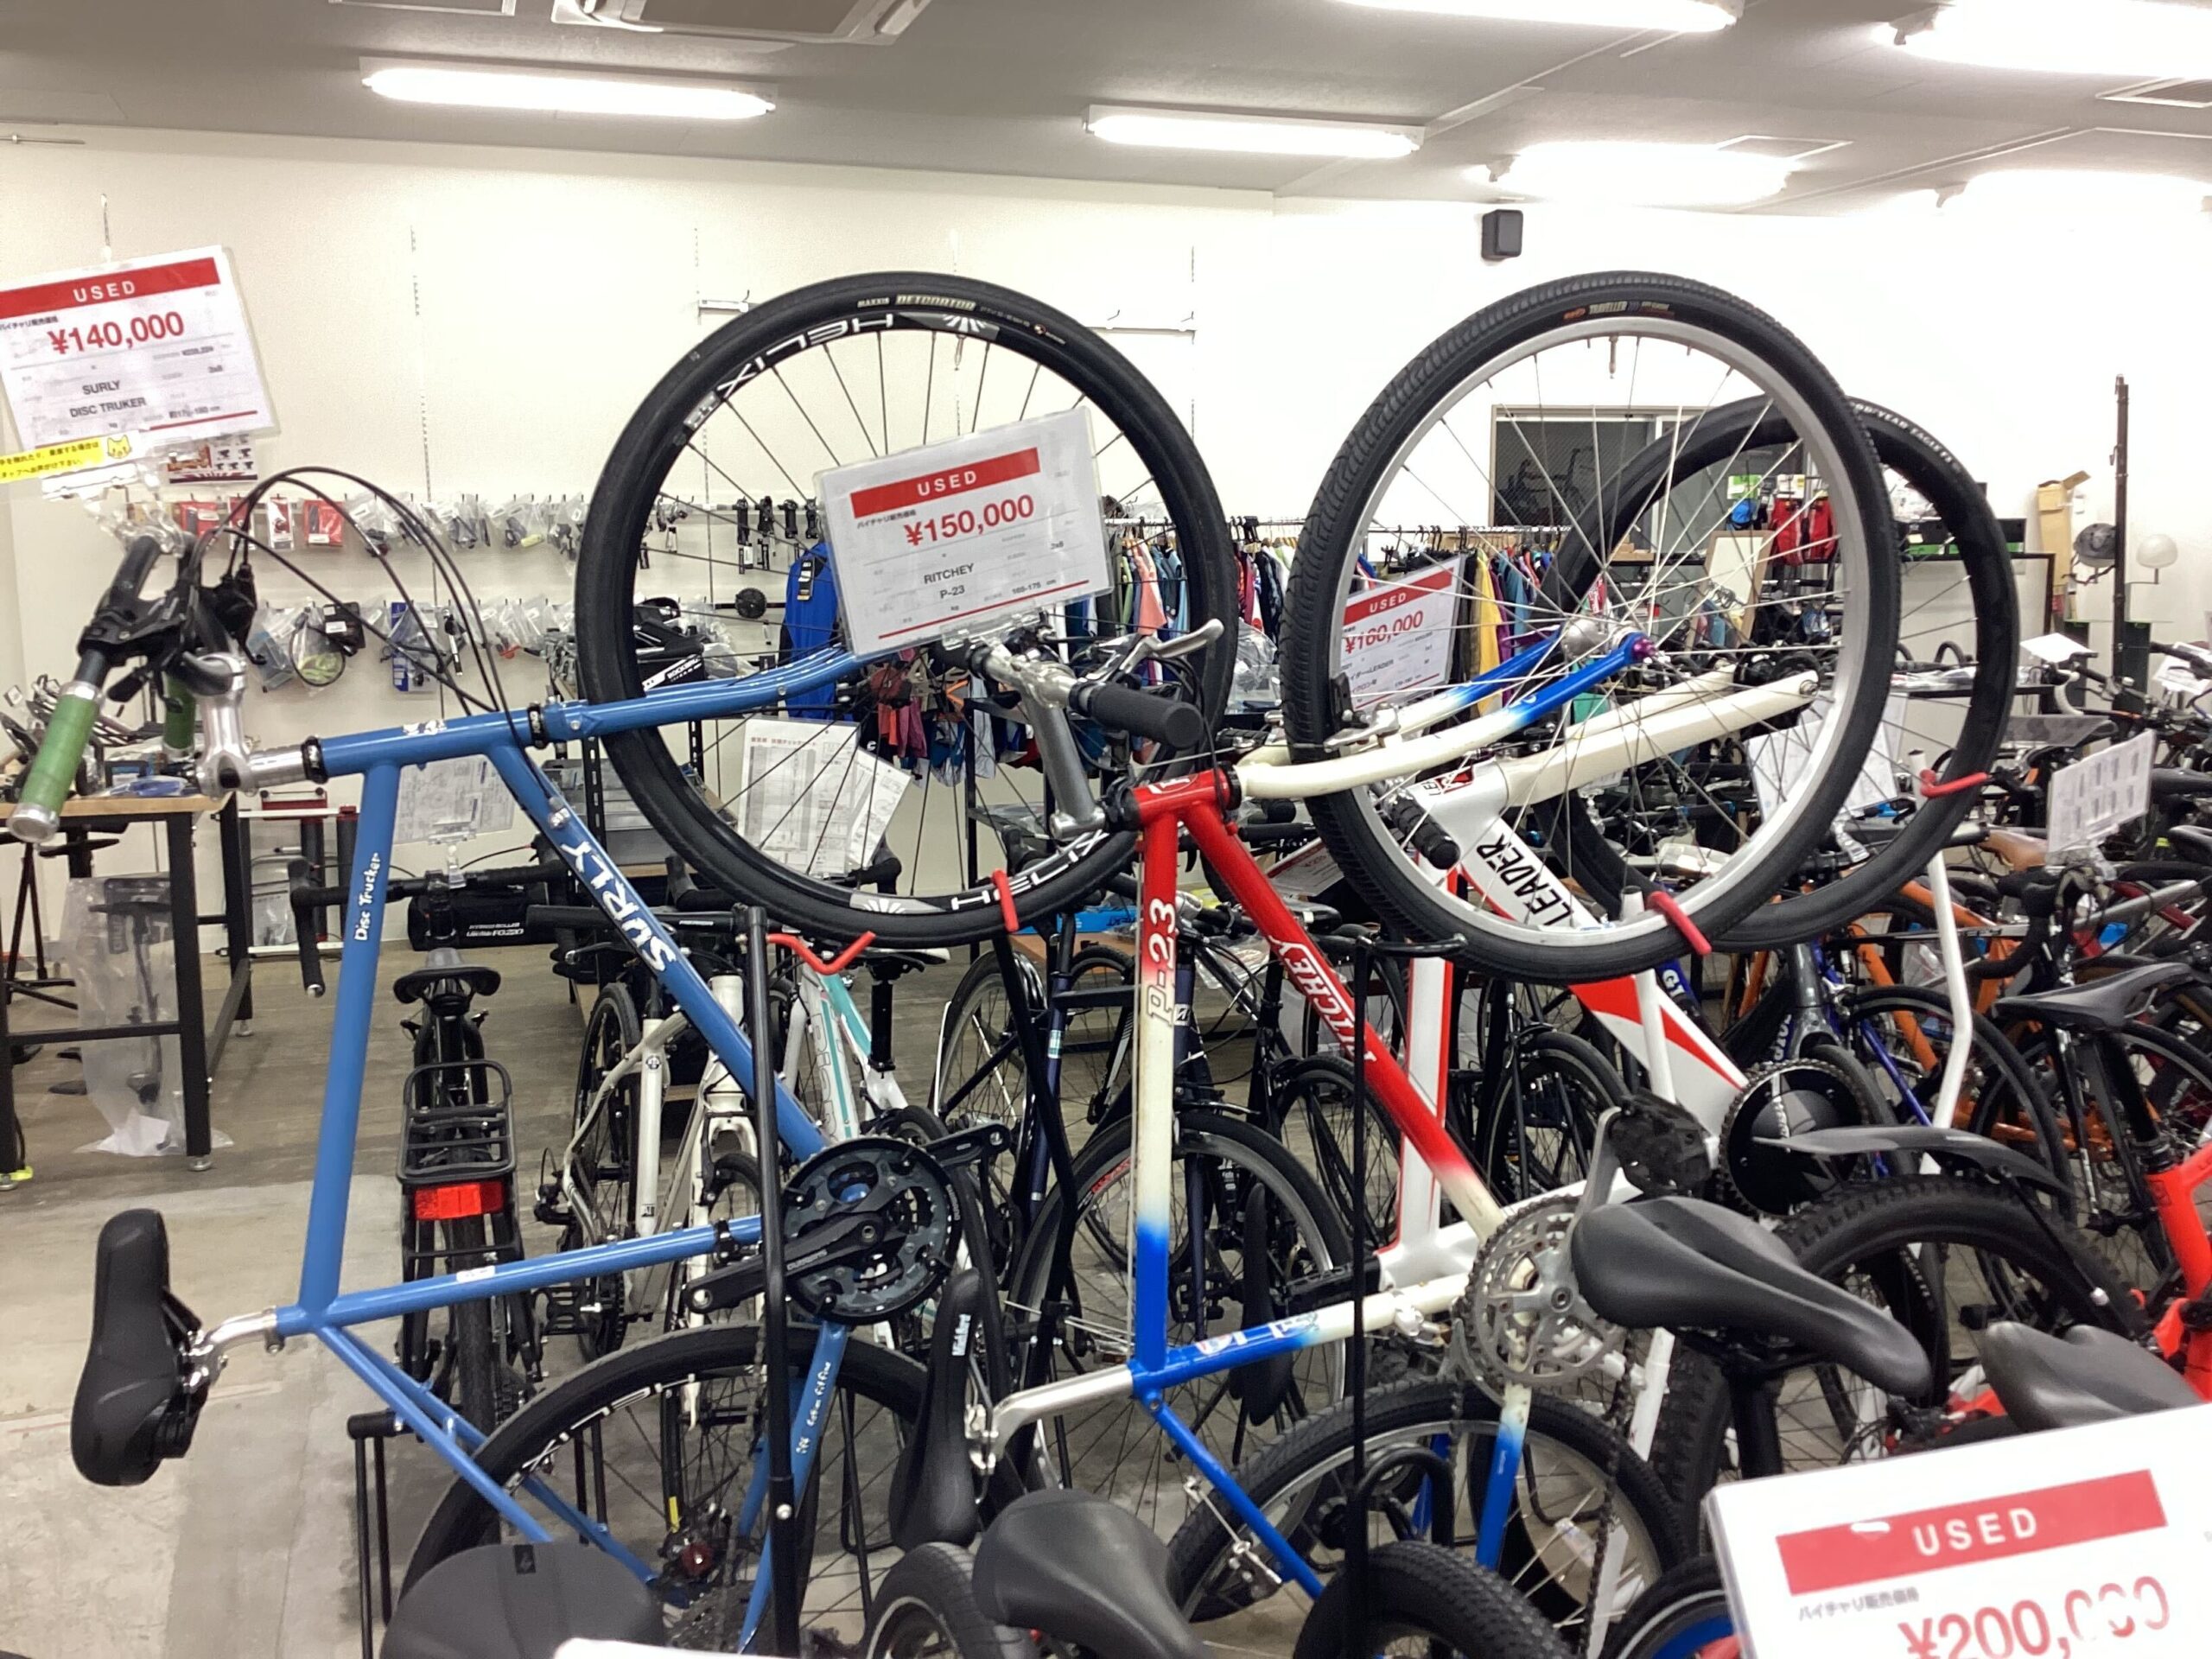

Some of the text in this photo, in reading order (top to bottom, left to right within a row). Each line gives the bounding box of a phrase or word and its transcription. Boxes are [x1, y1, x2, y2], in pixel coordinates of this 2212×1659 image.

[73, 281, 136, 303] USED
[47, 311, 185, 355] ¥140,000
[716, 313, 894, 399] HELIX
[69, 397, 148, 418] DISC TRUKER
[82, 380, 121, 396] SURLY
[917, 470, 977, 496] USED
[903, 494, 1035, 546] ¥150,000
[924, 563, 974, 585] RITCHEY
[940, 585, 965, 599] P-23
[1370, 592, 1407, 613] USED
[1344, 610, 1424, 654] ¥160,000
[353, 852, 382, 941] Disc Trucker
[1476, 834, 1573, 925] LEADER
[562, 841, 676, 971] SURLY
[1147, 898, 1176, 1027] P-23
[1912, 1507, 2038, 1556] USED
